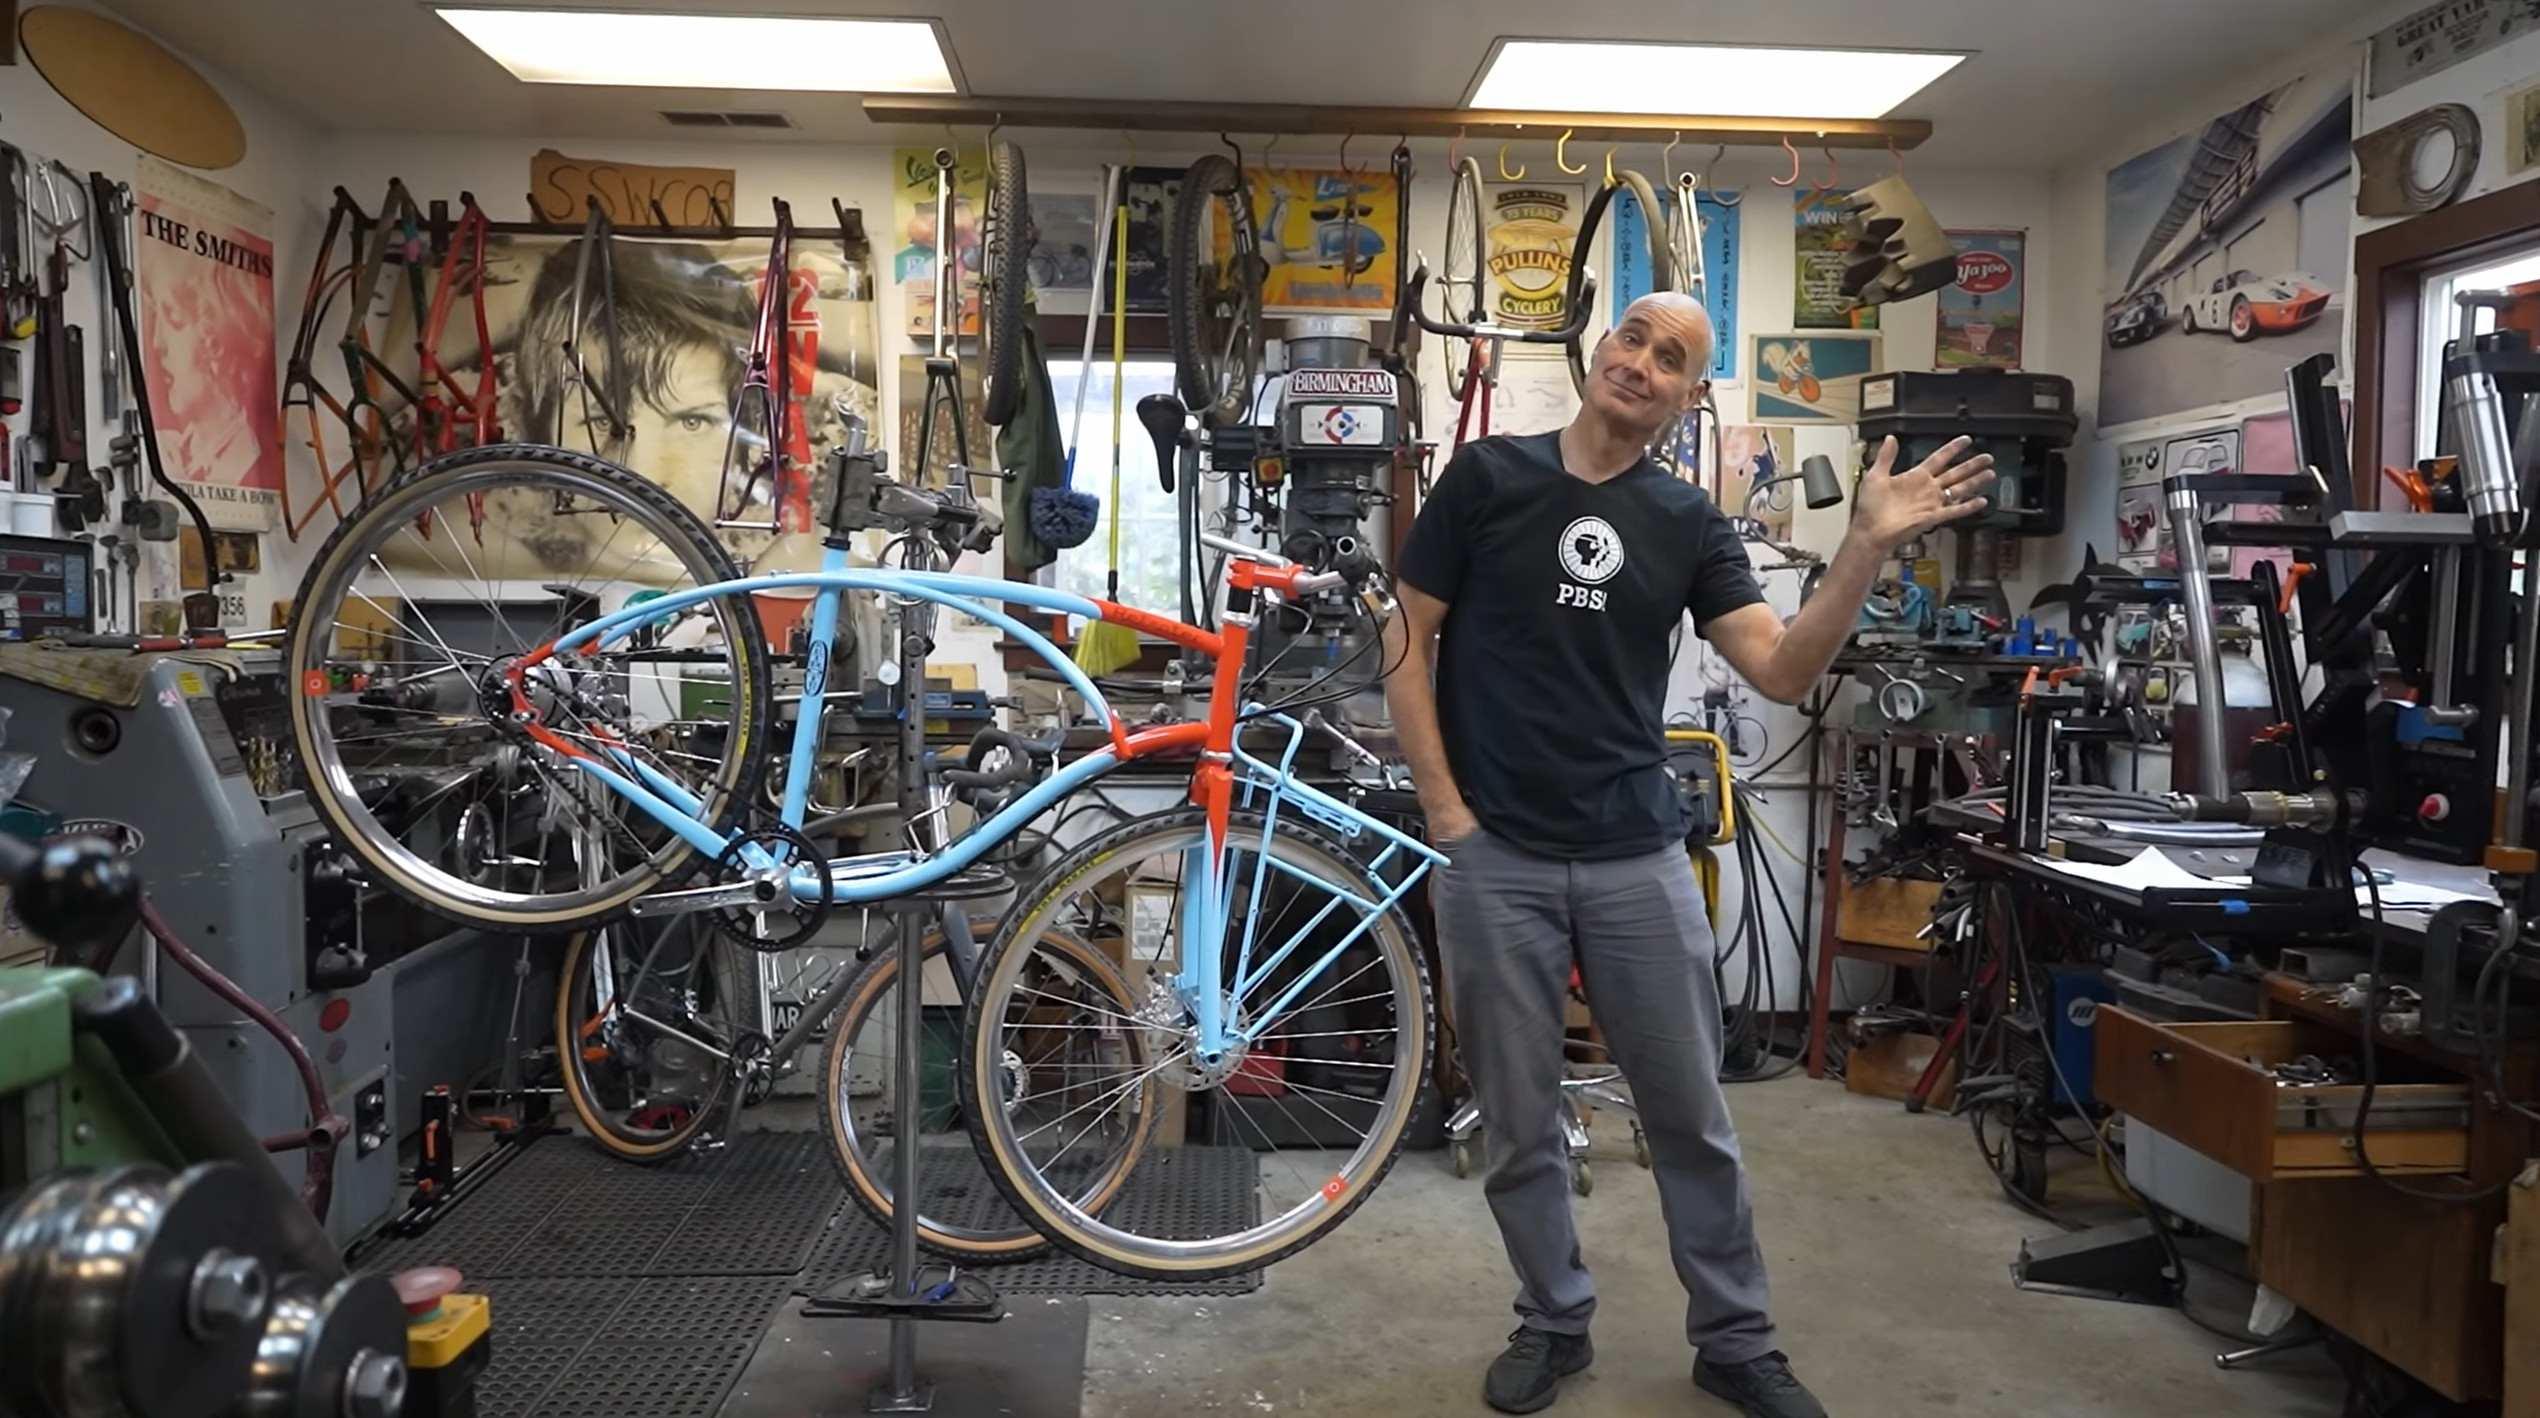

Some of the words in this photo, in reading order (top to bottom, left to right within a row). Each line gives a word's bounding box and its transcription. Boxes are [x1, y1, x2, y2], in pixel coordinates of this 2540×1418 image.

[1525, 207, 1559, 220] YEARS
[1804, 211, 1838, 224] WIN
[141, 209, 189, 251] THE
[194, 230, 272, 279] SMITHS
[1490, 251, 1573, 277] PULLINS
[1502, 299, 1561, 315] CYCLERY
[1294, 372, 1391, 393] BIRMINGHAM
[207, 485, 236, 502] TAKE
[240, 489, 248, 503] A
[222, 596, 246, 616] 356
